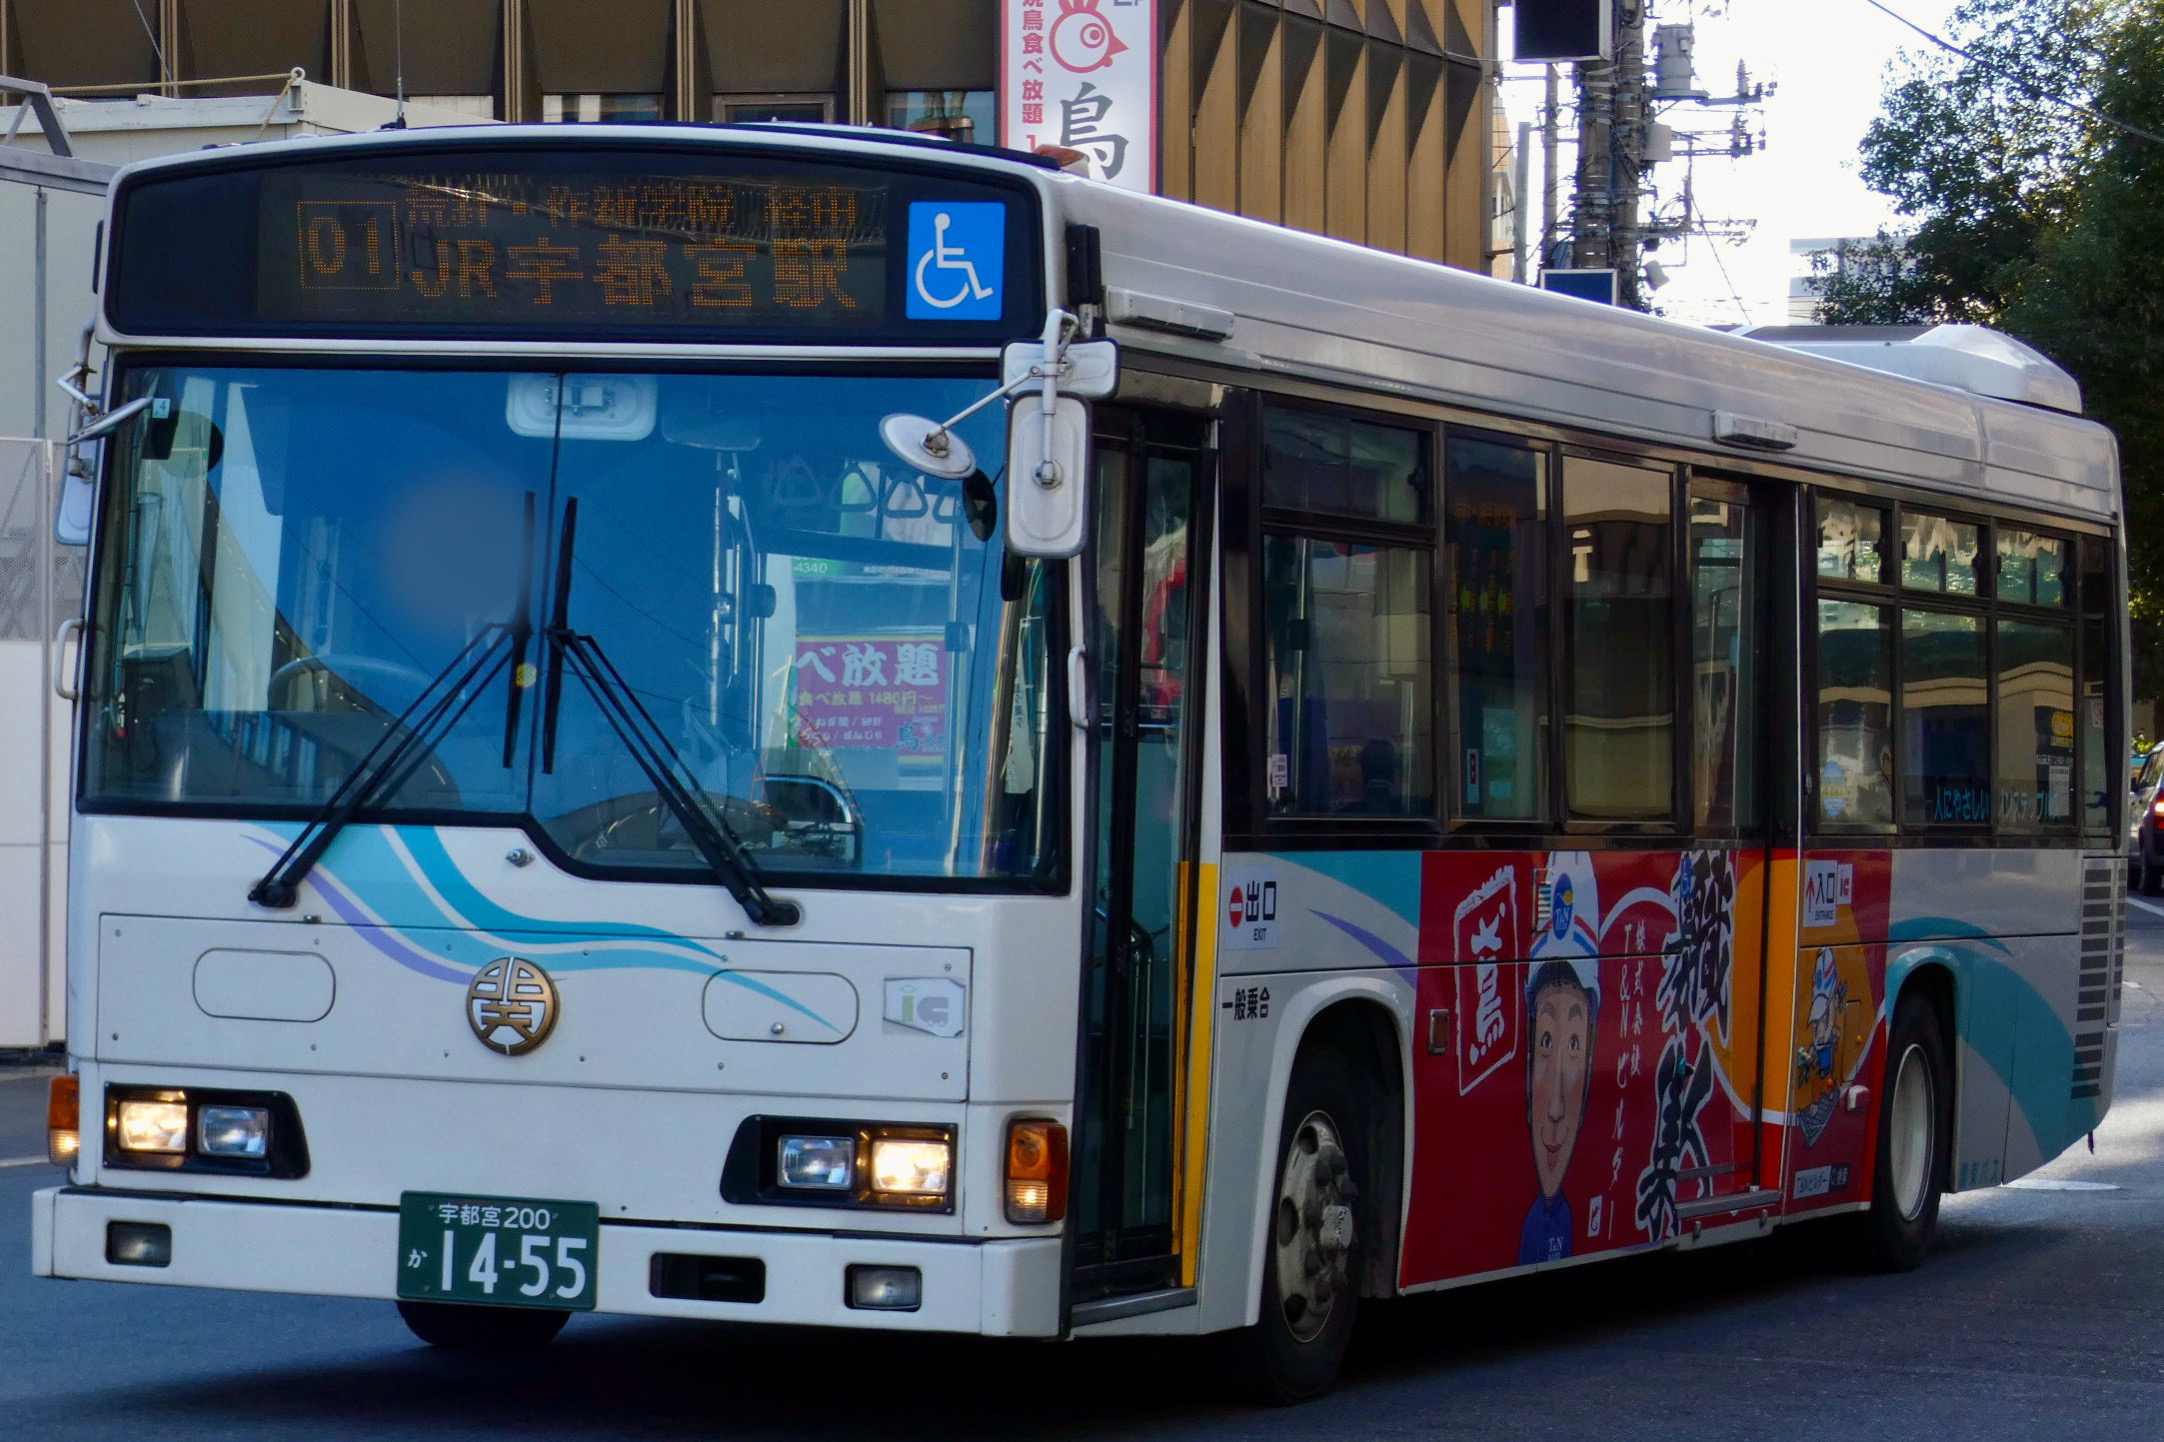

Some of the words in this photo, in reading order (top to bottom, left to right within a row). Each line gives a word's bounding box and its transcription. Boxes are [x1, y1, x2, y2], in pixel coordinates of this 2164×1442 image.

[1060, 81, 1130, 180] 鳥
[306, 216, 380, 276] 01
[410, 236, 858, 308] JR宇都宮駅
[797, 643, 939, 686] べ放題
[1245, 880, 1277, 922] 出口
[1815, 872, 1835, 905] 入口
[1253, 927, 1268, 941] EXIT
[1222, 986, 1271, 1021] 一般乗合
[438, 1203, 551, 1230] 宇都宮200
[407, 1248, 428, 1269] か
[441, 1229, 588, 1299] 14-55
